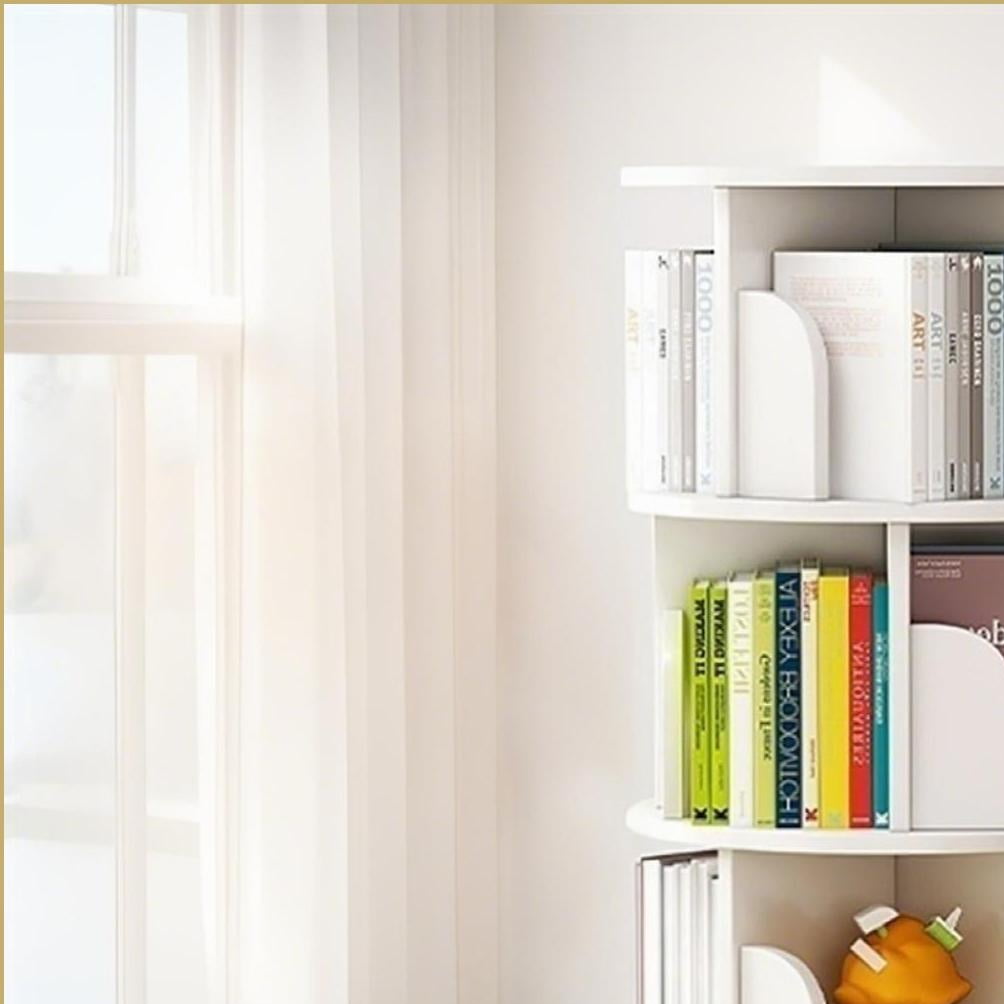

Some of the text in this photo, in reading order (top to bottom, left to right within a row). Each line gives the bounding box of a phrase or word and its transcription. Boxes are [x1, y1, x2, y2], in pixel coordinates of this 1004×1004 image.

[697, 262, 713, 333] 1000
[988, 263, 1002, 335] 1000
[912, 312, 925, 351] ART
[931, 312, 942, 351] ART
